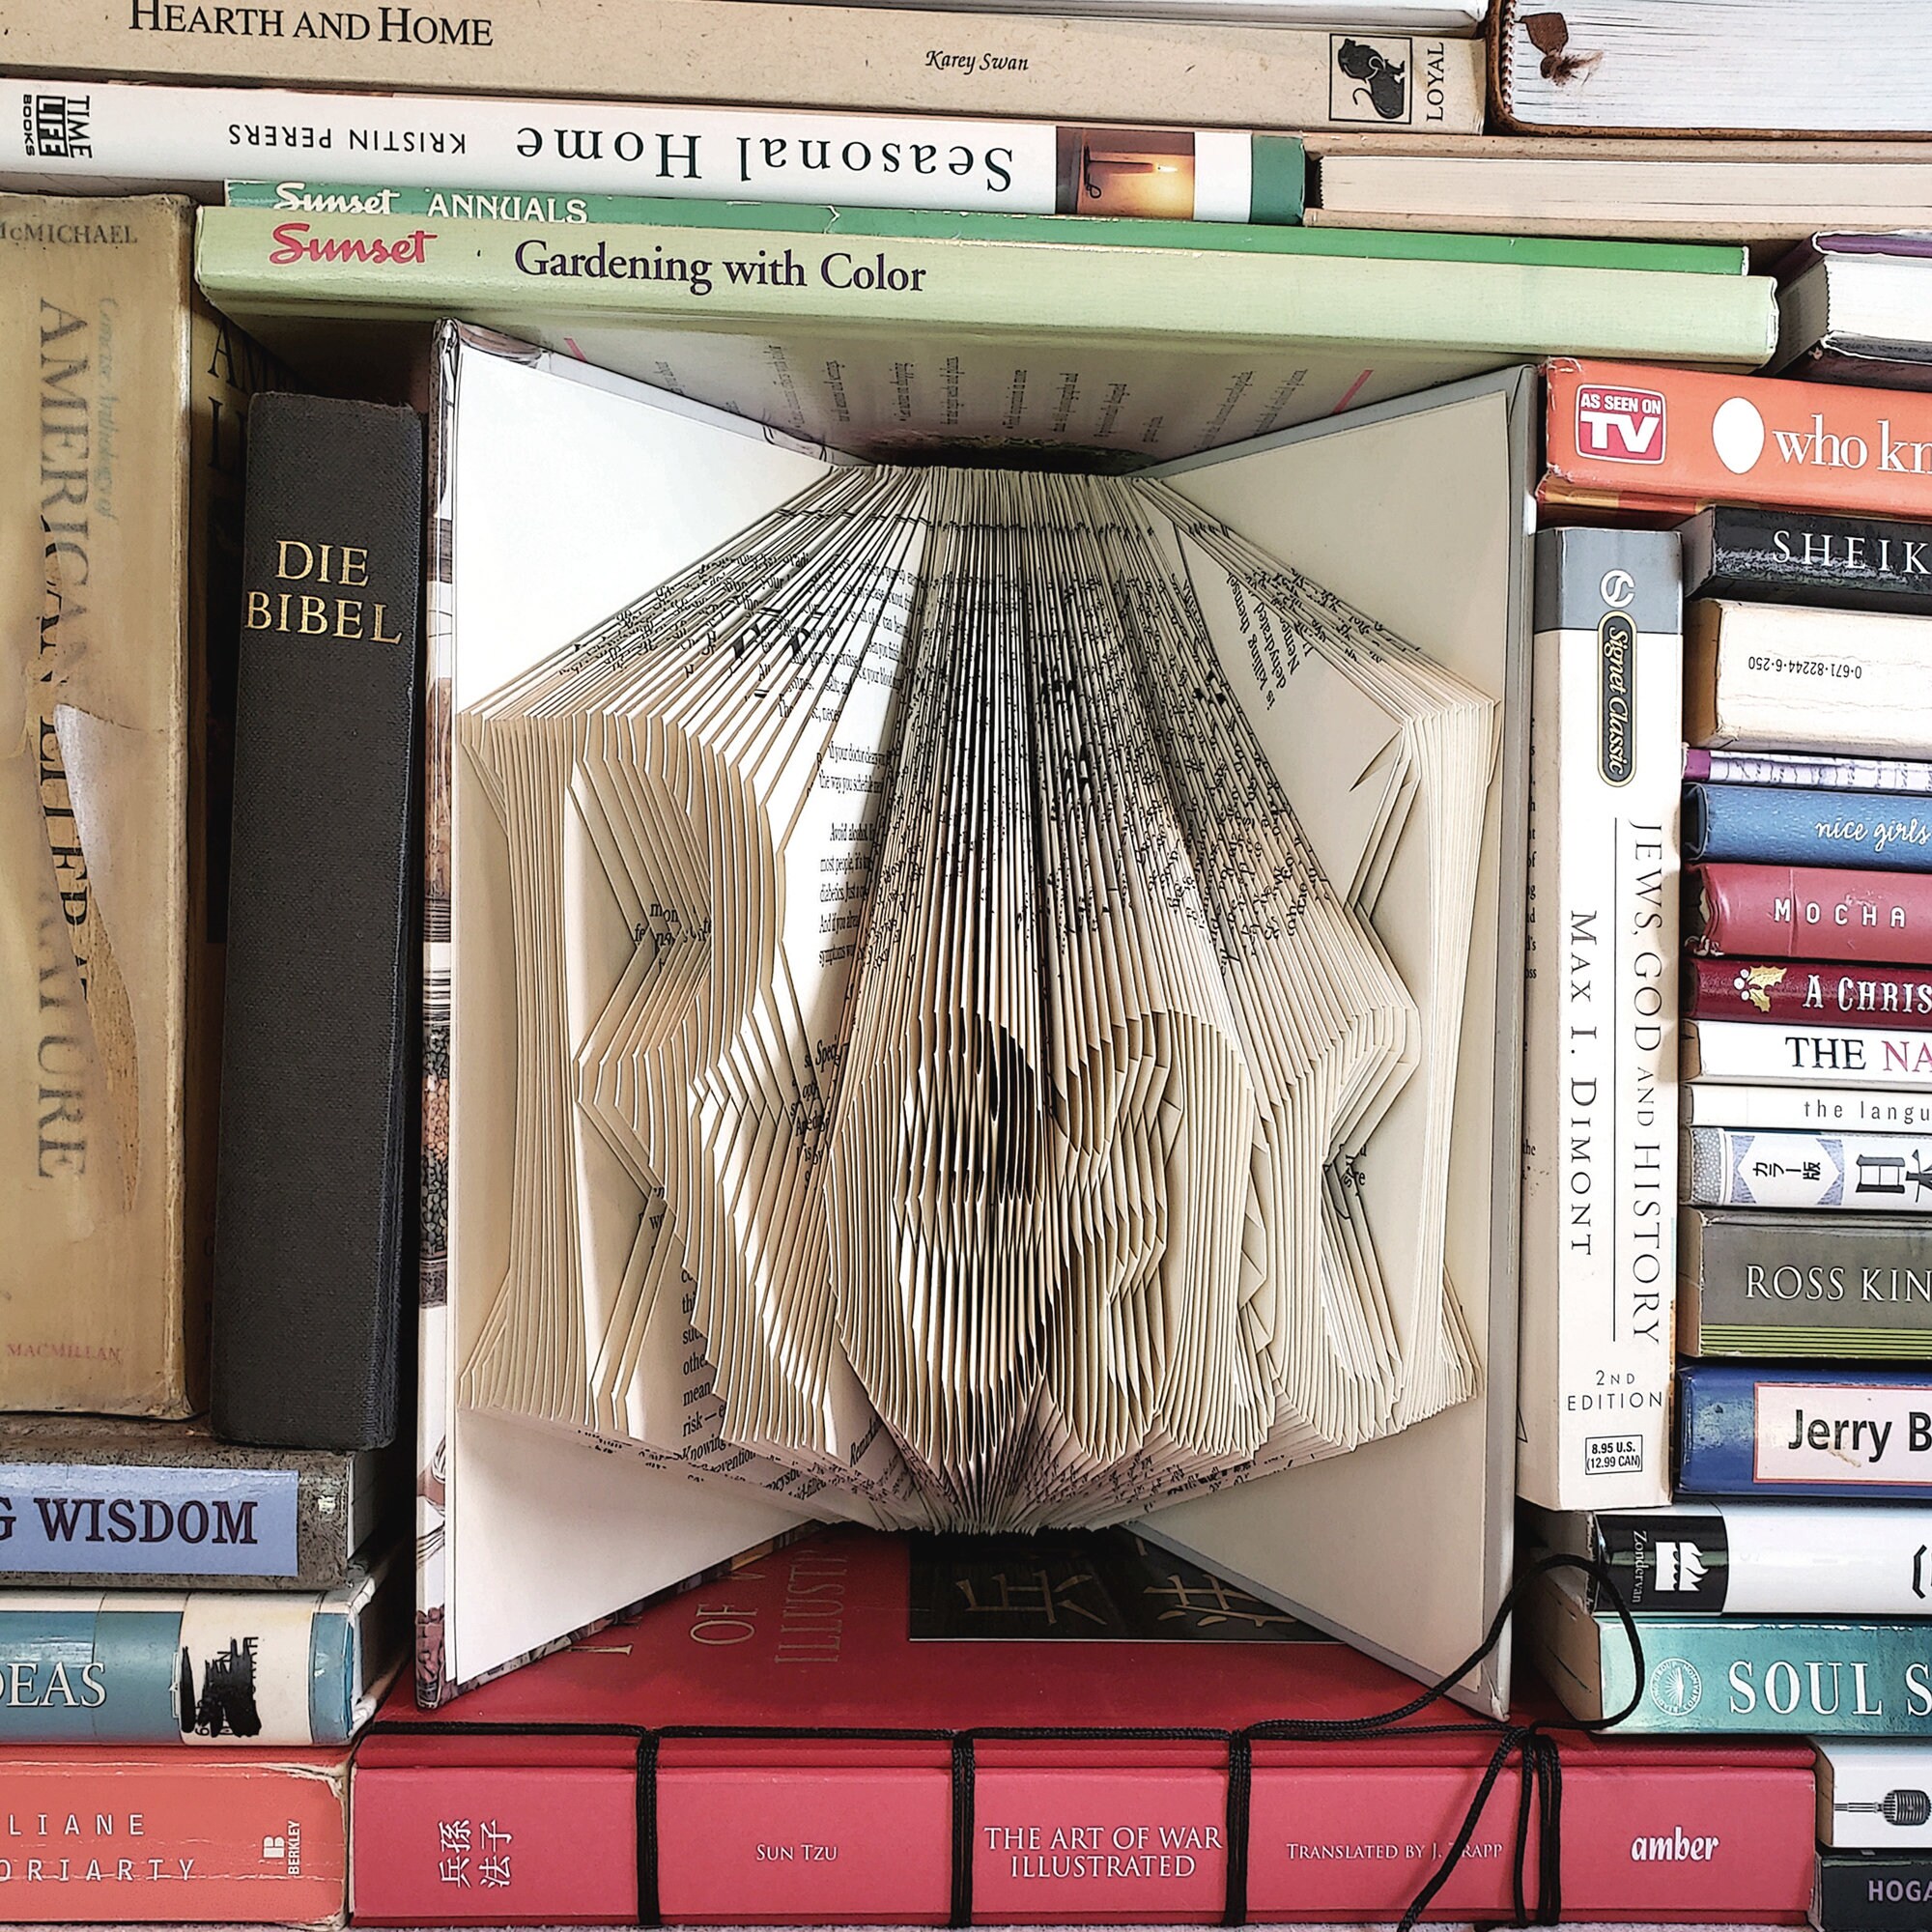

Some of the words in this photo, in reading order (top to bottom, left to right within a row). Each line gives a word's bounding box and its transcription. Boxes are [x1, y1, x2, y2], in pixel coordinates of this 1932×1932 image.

[129, 0, 284, 37] HEARTH
[294, 12, 370, 40] AND
[377, 8, 494, 46] HOME
[925, 49, 976, 76] Karey
[980, 52, 1029, 72] Swan
[1425, 41, 1444, 123] LOYAL
[23, 94, 36, 156] BOOKS
[37, 95, 69, 158] LIFE
[68, 95, 93, 158] TIME
[228, 124, 332, 149] PERERS
[349, 128, 467, 155] KRISTIN
[516, 127, 702, 179] Home
[738, 136, 1014, 192] Seasonal
[273, 181, 400, 215] Sunset
[427, 192, 588, 224] ANNUALS
[269, 221, 438, 266] Sunset
[514, 239, 712, 296] Gardening
[722, 250, 808, 287] with
[820, 252, 927, 292] Color
[1580, 393, 1601, 410] AS
[1604, 394, 1638, 413] SEEN
[1641, 398, 1662, 415] ON
[1579, 412, 1660, 453] TV
[1773, 413, 1868, 469] who
[275, 539, 369, 588] DIE
[1773, 530, 1932, 576] SHEIK
[244, 590, 404, 645] BIBEL
[1603, 626, 1630, 695] Signet
[1607, 697, 1630, 775] Classic
[1815, 817, 1868, 840] nice
[1873, 817, 1932, 854] girls
[1629, 819, 1663, 937] JEWS,
[1774, 898, 1907, 929] MOCHA
[1570, 910, 1598, 1004] MAX
[1634, 952, 1662, 1053] GOD
[1802, 975, 1825, 1009] A
[1837, 976, 1932, 1016] CHRIS
[1570, 1025, 1598, 1055] I.
[1785, 1037, 1867, 1070] THE
[1636, 1066, 1655, 1128] AND
[1804, 1099, 1843, 1119] the
[1861, 1099, 1932, 1125] langu
[1570, 1077, 1598, 1256] DIMONT
[1633, 1142, 1662, 1346] HISTORY
[1746, 1264, 1845, 1301] ROSS
[1861, 1266, 1932, 1302] KIN
[1567, 1391, 1663, 1411] EDITION
[1595, 1370, 1635, 1386] 2ND
[1592, 1442, 1613, 1454] 8.95
[1616, 1441, 1635, 1453] U.S.
[1788, 1408, 1893, 1463] Jerry
[1586, 1456, 1616, 1471] (12.99
[1618, 1454, 1640, 1468] CAN)
[33, 1497, 259, 1545] WISDOM
[1632, 1530, 1647, 1604] Zondervan
[690, 1604, 758, 1645] OF
[0, 1662, 107, 1708] EAS
[1728, 1660, 1884, 1718] SOUL
[9, 1813, 145, 1837] LIANE
[287, 1820, 301, 1876] BERKLEY
[983, 1826, 1041, 1851] THE
[1049, 1826, 1103, 1851] ART
[1111, 1826, 1150, 1851] OF
[1157, 1825, 1224, 1850] WAR
[1630, 1825, 1719, 1862] amber
[1009, 1854, 1197, 1879] ILLUSTRATED
[1431, 1843, 1442, 1862] J.
[1448, 1842, 1503, 1860] RAPP
